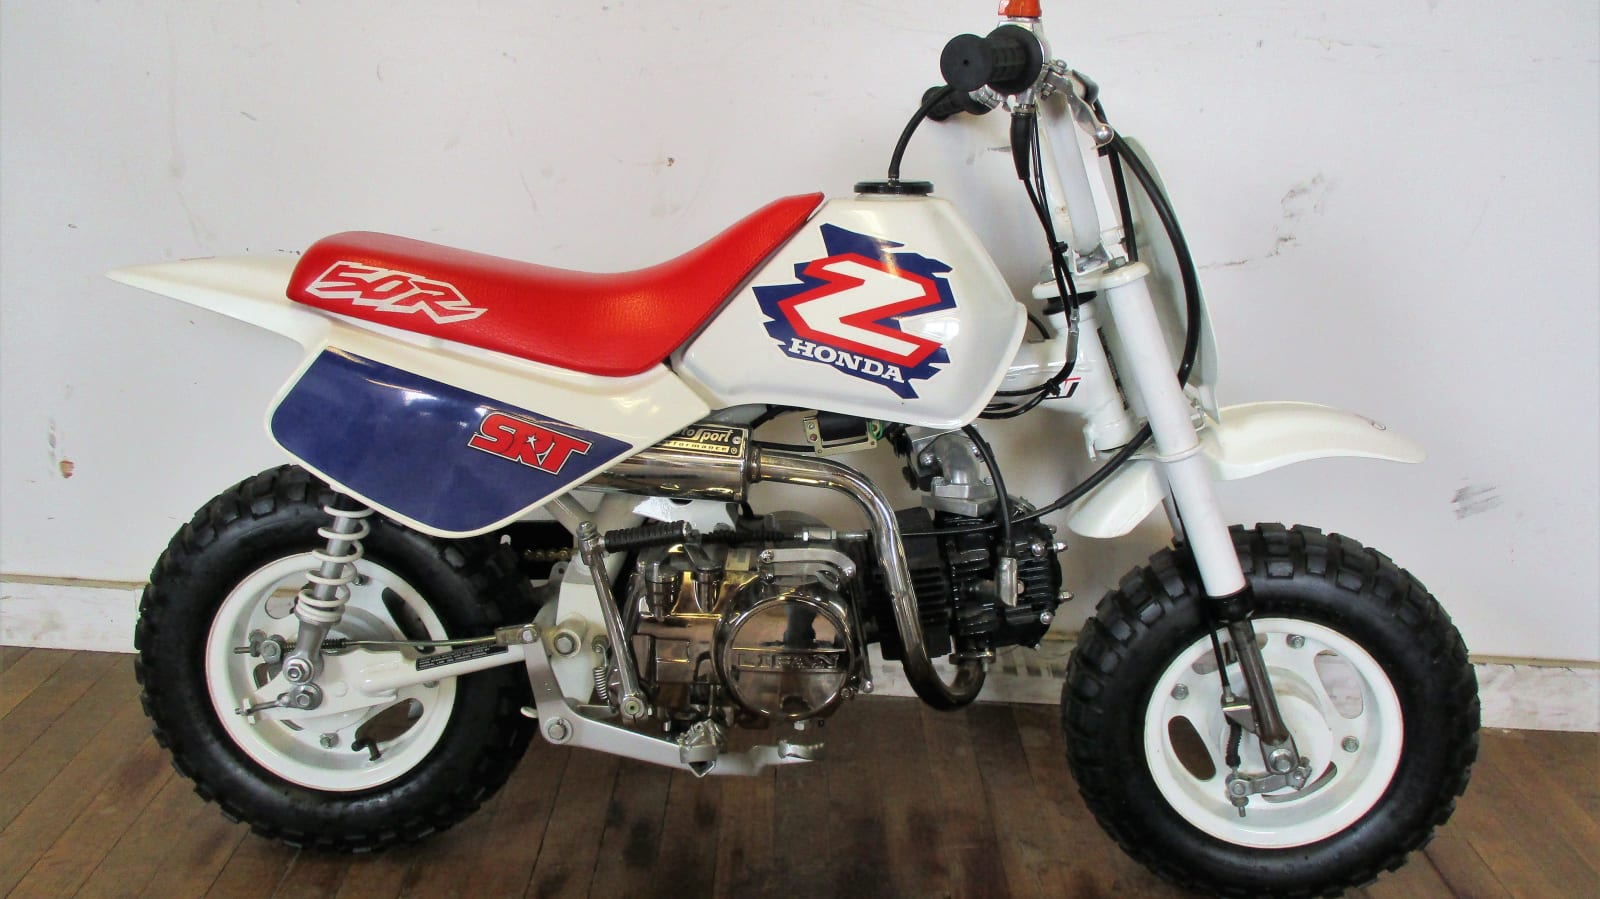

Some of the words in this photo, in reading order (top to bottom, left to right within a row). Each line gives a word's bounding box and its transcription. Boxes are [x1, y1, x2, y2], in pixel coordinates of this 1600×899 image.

[788, 338, 905, 384] HONDA
[467, 412, 593, 475] SRT
[737, 652, 841, 670] LIFAN
